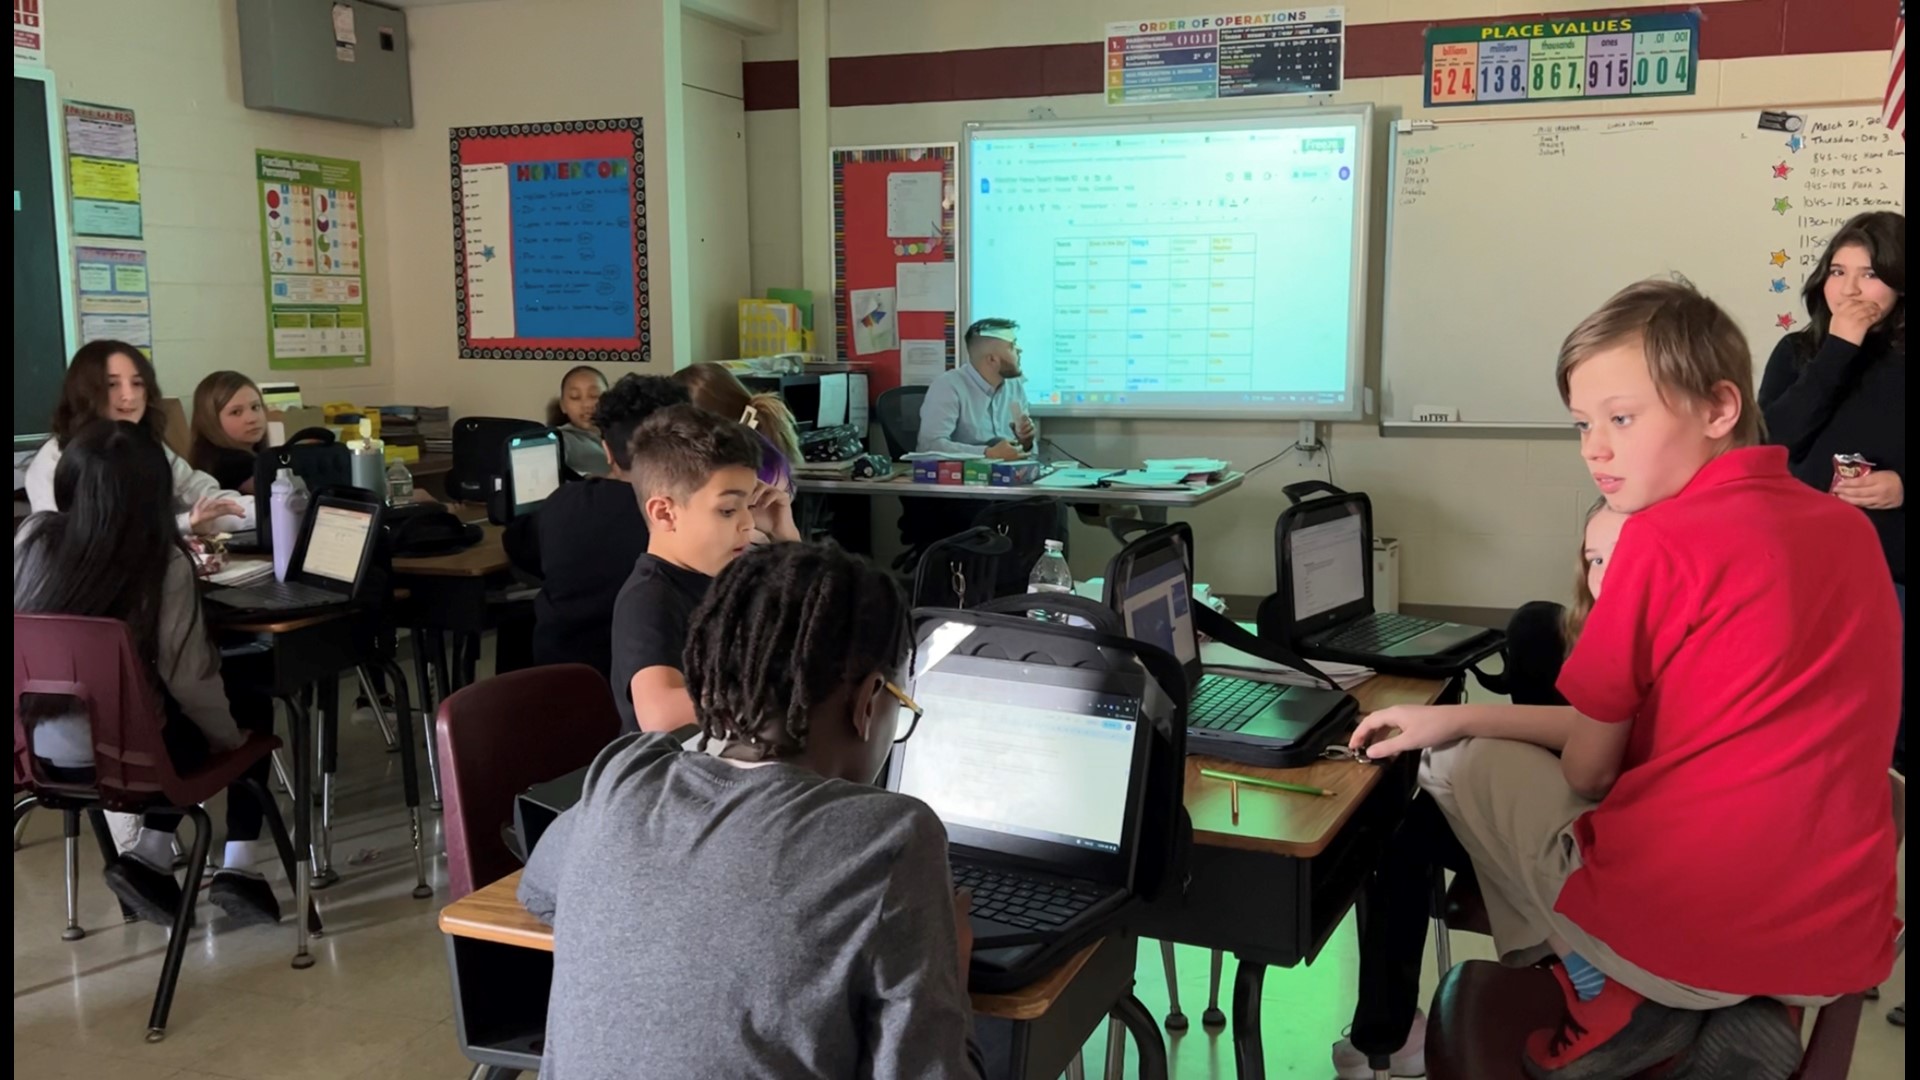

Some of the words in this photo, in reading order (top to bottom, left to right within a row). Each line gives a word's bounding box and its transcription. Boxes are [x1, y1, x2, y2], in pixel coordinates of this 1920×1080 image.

[1139, 20, 1185, 32] ORDER
[1192, 18, 1209, 28] OF
[1215, 11, 1306, 26] OPERATIONS
[1481, 24, 1544, 39] PLACE
[1551, 19, 1632, 35] VALUES
[1442, 46, 1468, 56] billions
[1489, 43, 1518, 53] millions
[1541, 39, 1575, 50] thousands
[1601, 39, 1618, 47] ones
[1811, 120, 1843, 134] March
[1881, 132, 1890, 143] 3
